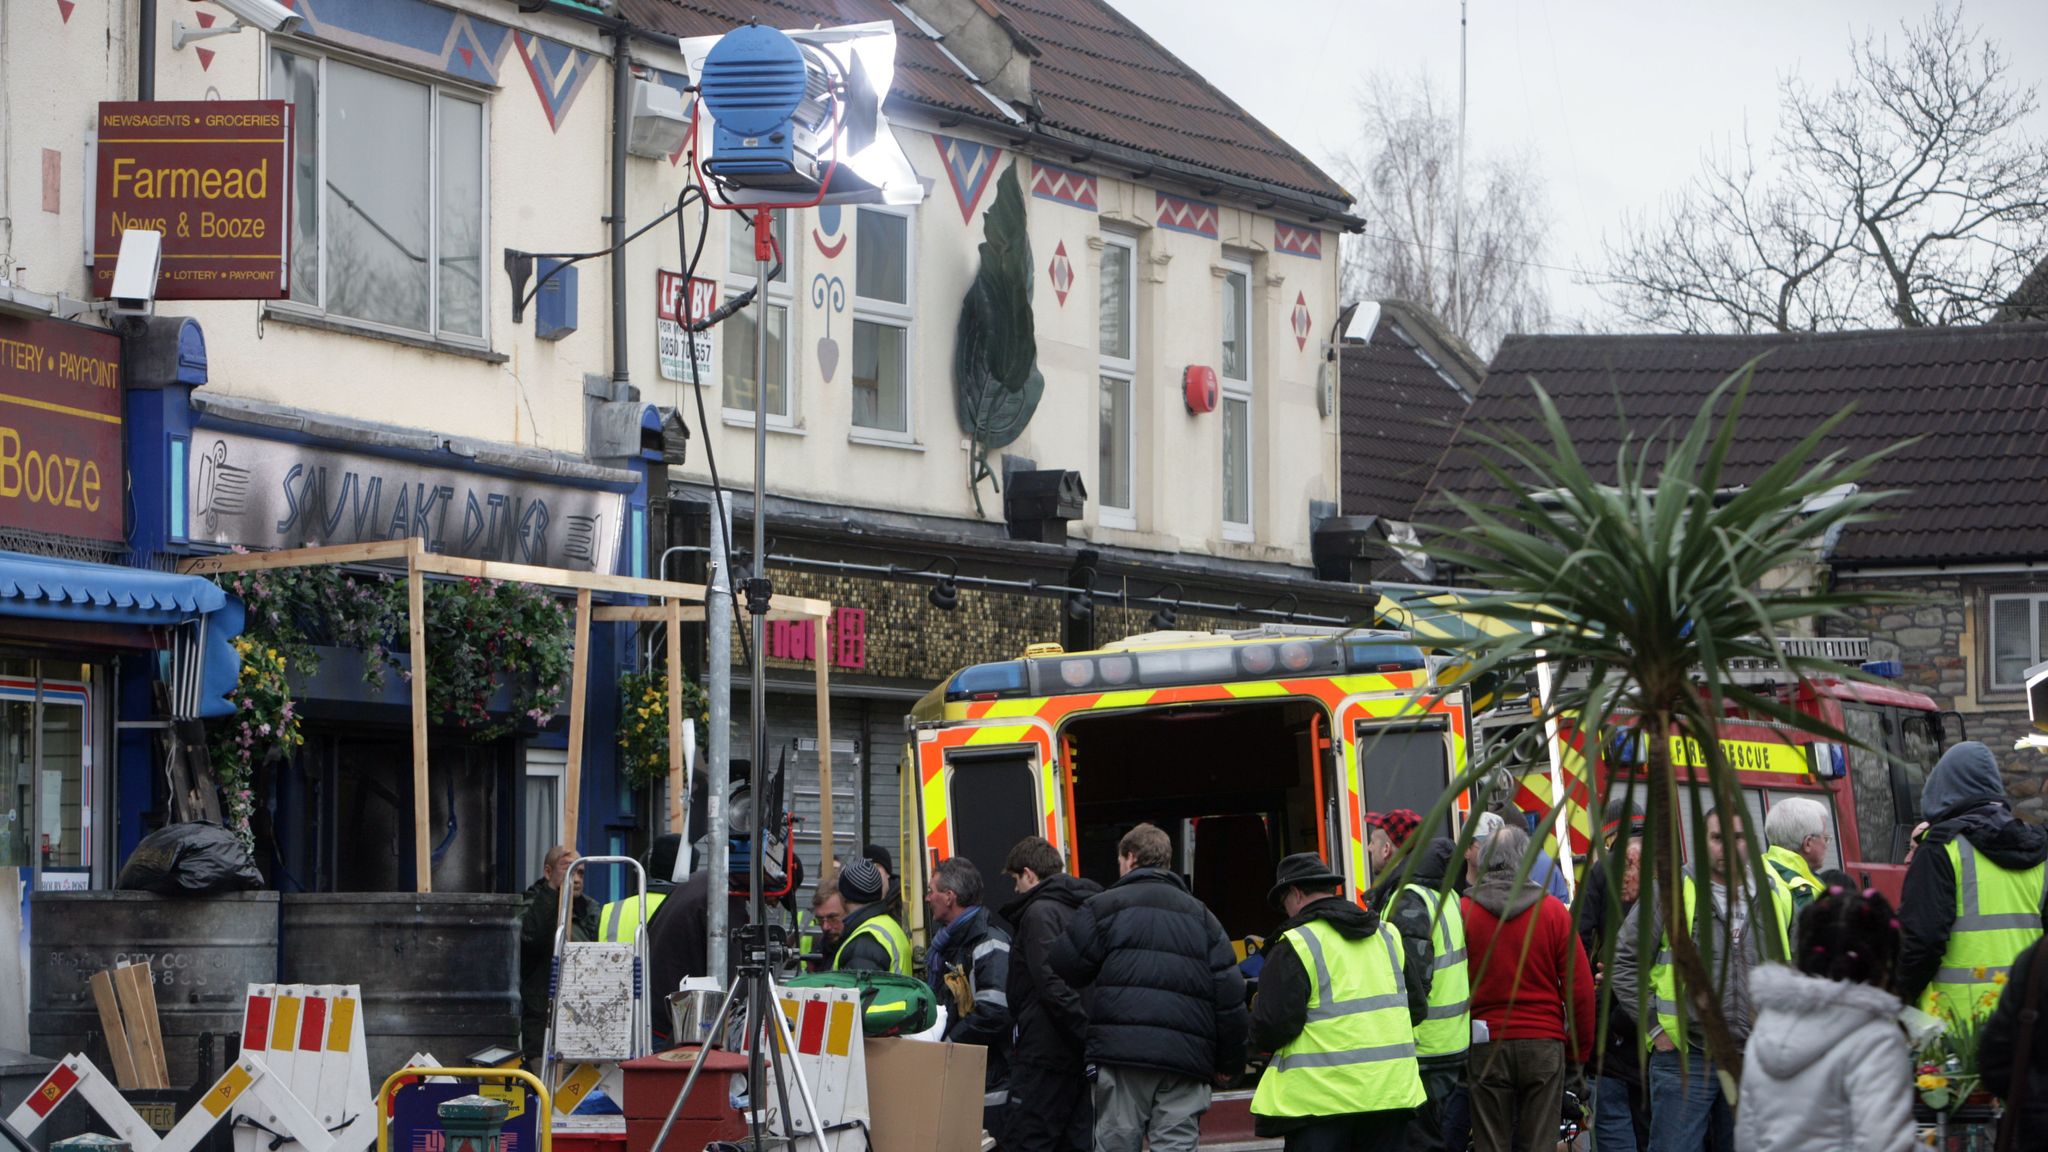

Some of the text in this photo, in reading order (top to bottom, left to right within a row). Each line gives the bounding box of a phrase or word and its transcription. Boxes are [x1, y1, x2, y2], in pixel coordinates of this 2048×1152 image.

[103, 114, 280, 127] NEWSAGENTS GROCERIES
[112, 158, 268, 200] Farmead
[111, 211, 266, 239] News & Booze
[173, 270, 218, 281] LOTTERY
[229, 271, 276, 281] PAYPOINT
[692, 280, 715, 319] BY
[661, 335, 711, 363] 0850 70557
[59, 351, 119, 390] PAYPOINT
[0, 426, 102, 513] Booze
[276, 462, 551, 566] SOUVLAKI DINER
[1675, 739, 1771, 770] FRE RESCUE
